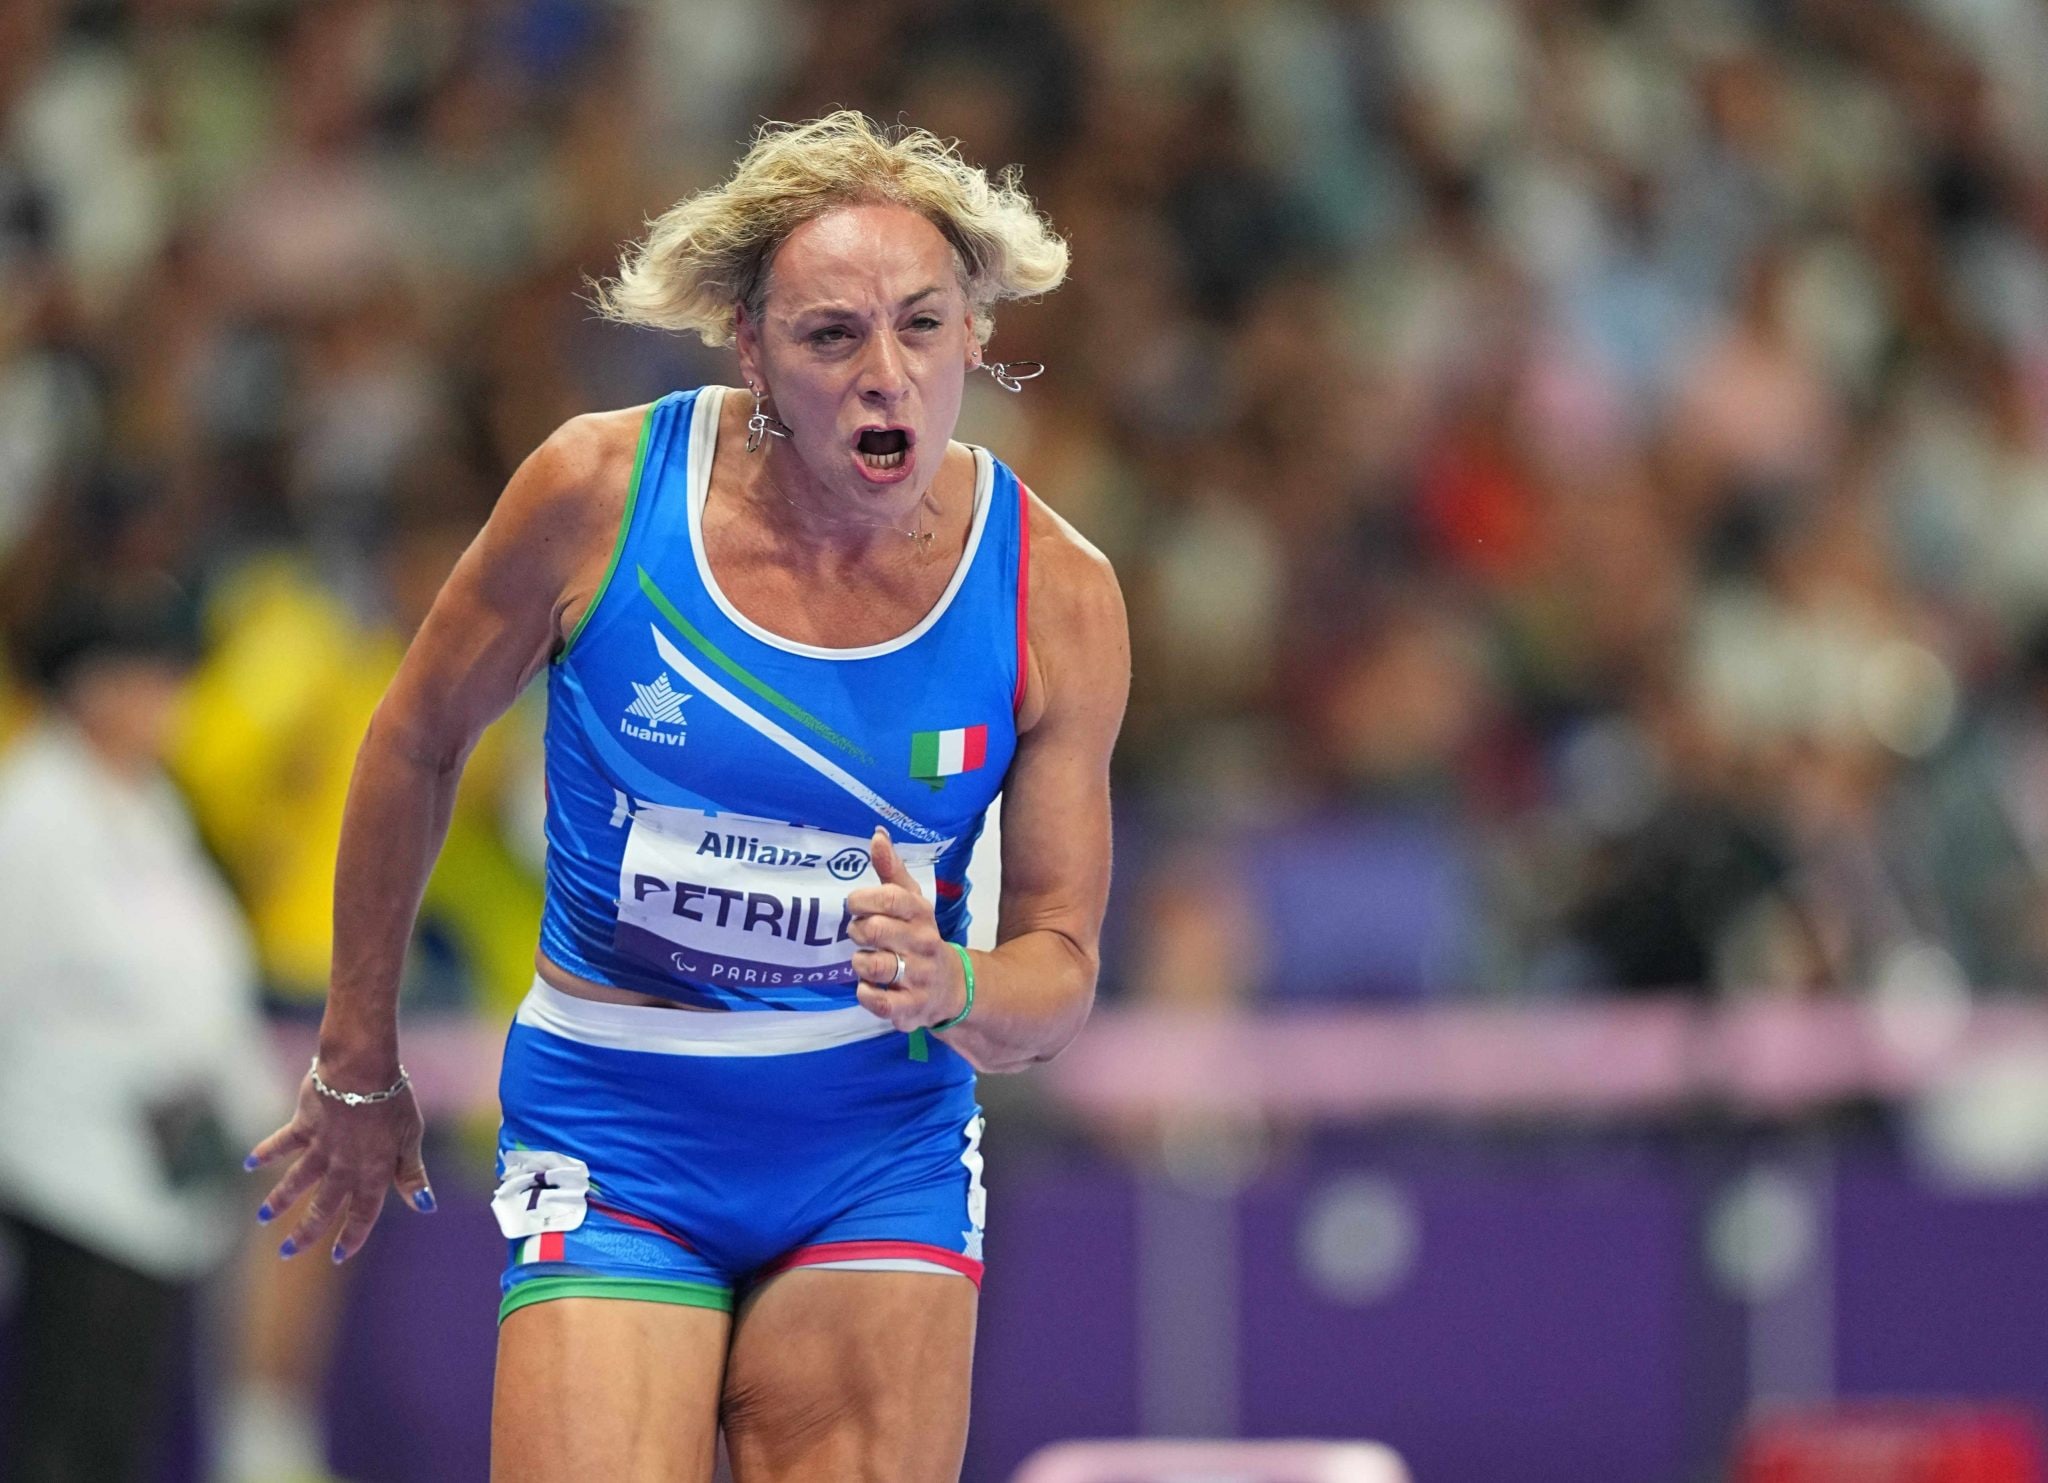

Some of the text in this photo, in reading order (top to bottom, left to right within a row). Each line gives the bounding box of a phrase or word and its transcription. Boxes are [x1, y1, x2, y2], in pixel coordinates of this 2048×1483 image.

[620, 718, 687, 746] luanvi
[696, 830, 822, 868] Allianz
[711, 963, 854, 984] PARIS 2024
